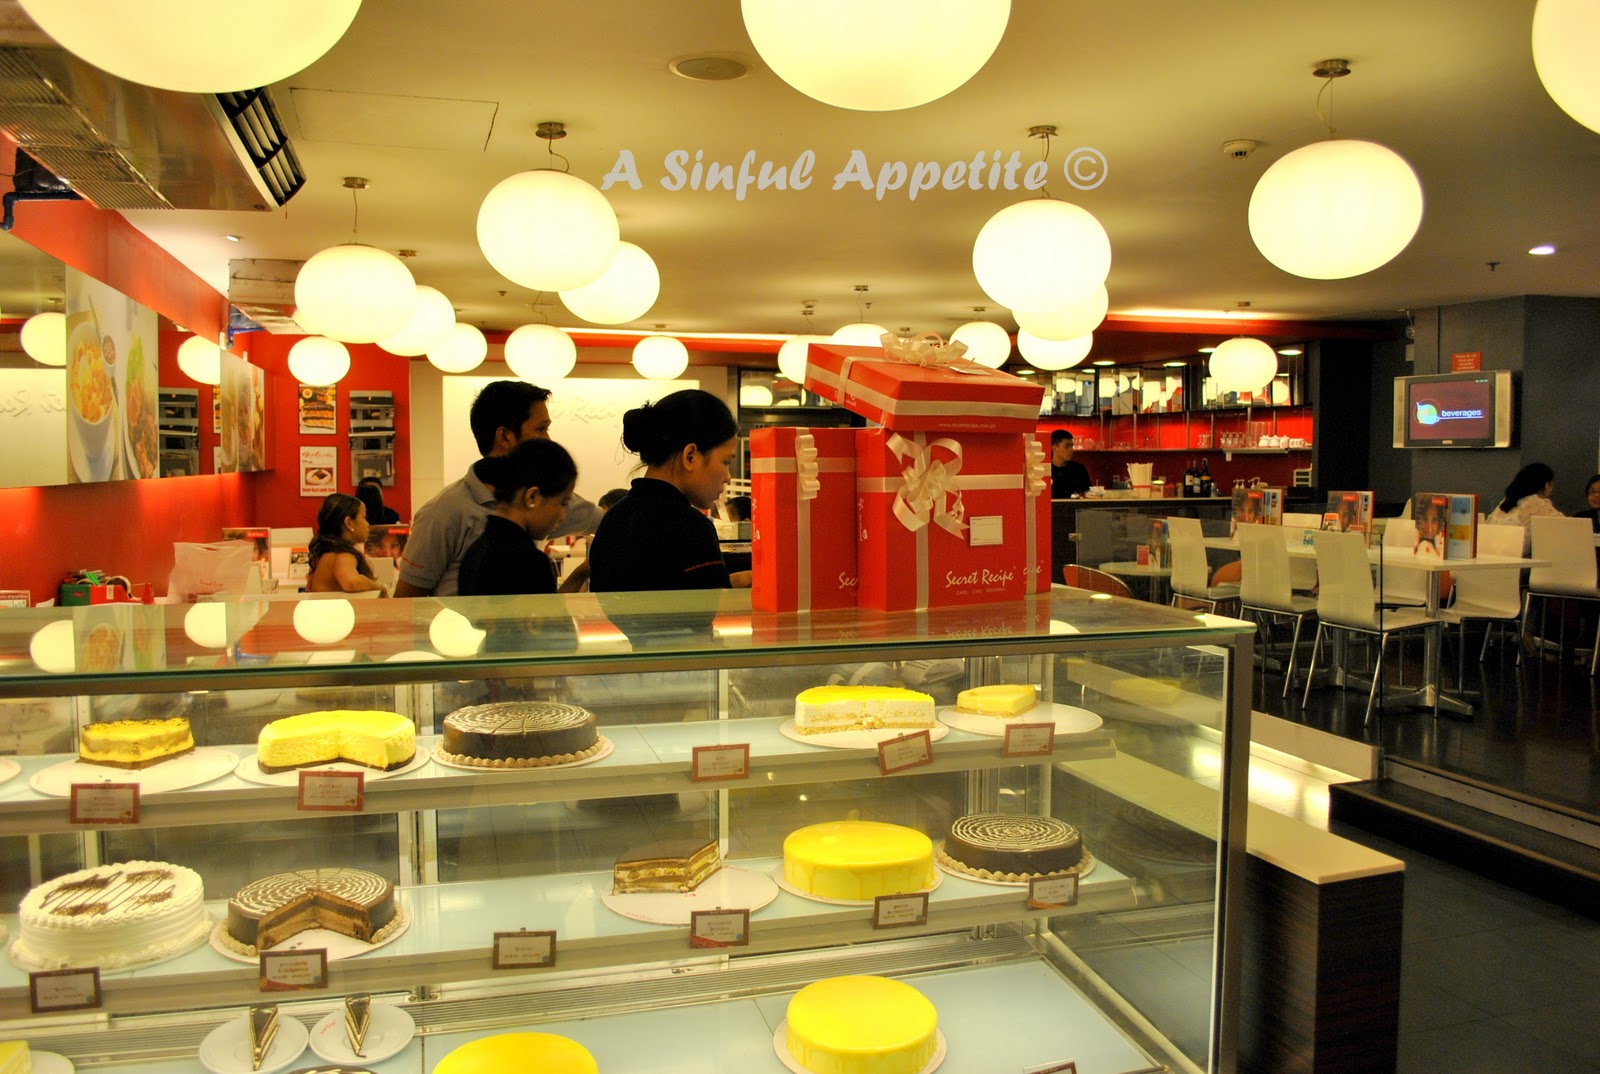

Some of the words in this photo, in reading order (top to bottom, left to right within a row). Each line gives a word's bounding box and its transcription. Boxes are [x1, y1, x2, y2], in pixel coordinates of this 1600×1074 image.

[1441, 409, 1482, 418] beverages
[838, 571, 858, 589] Sec
[946, 570, 978, 588] Secret
[982, 568, 1014, 587] Recipe
